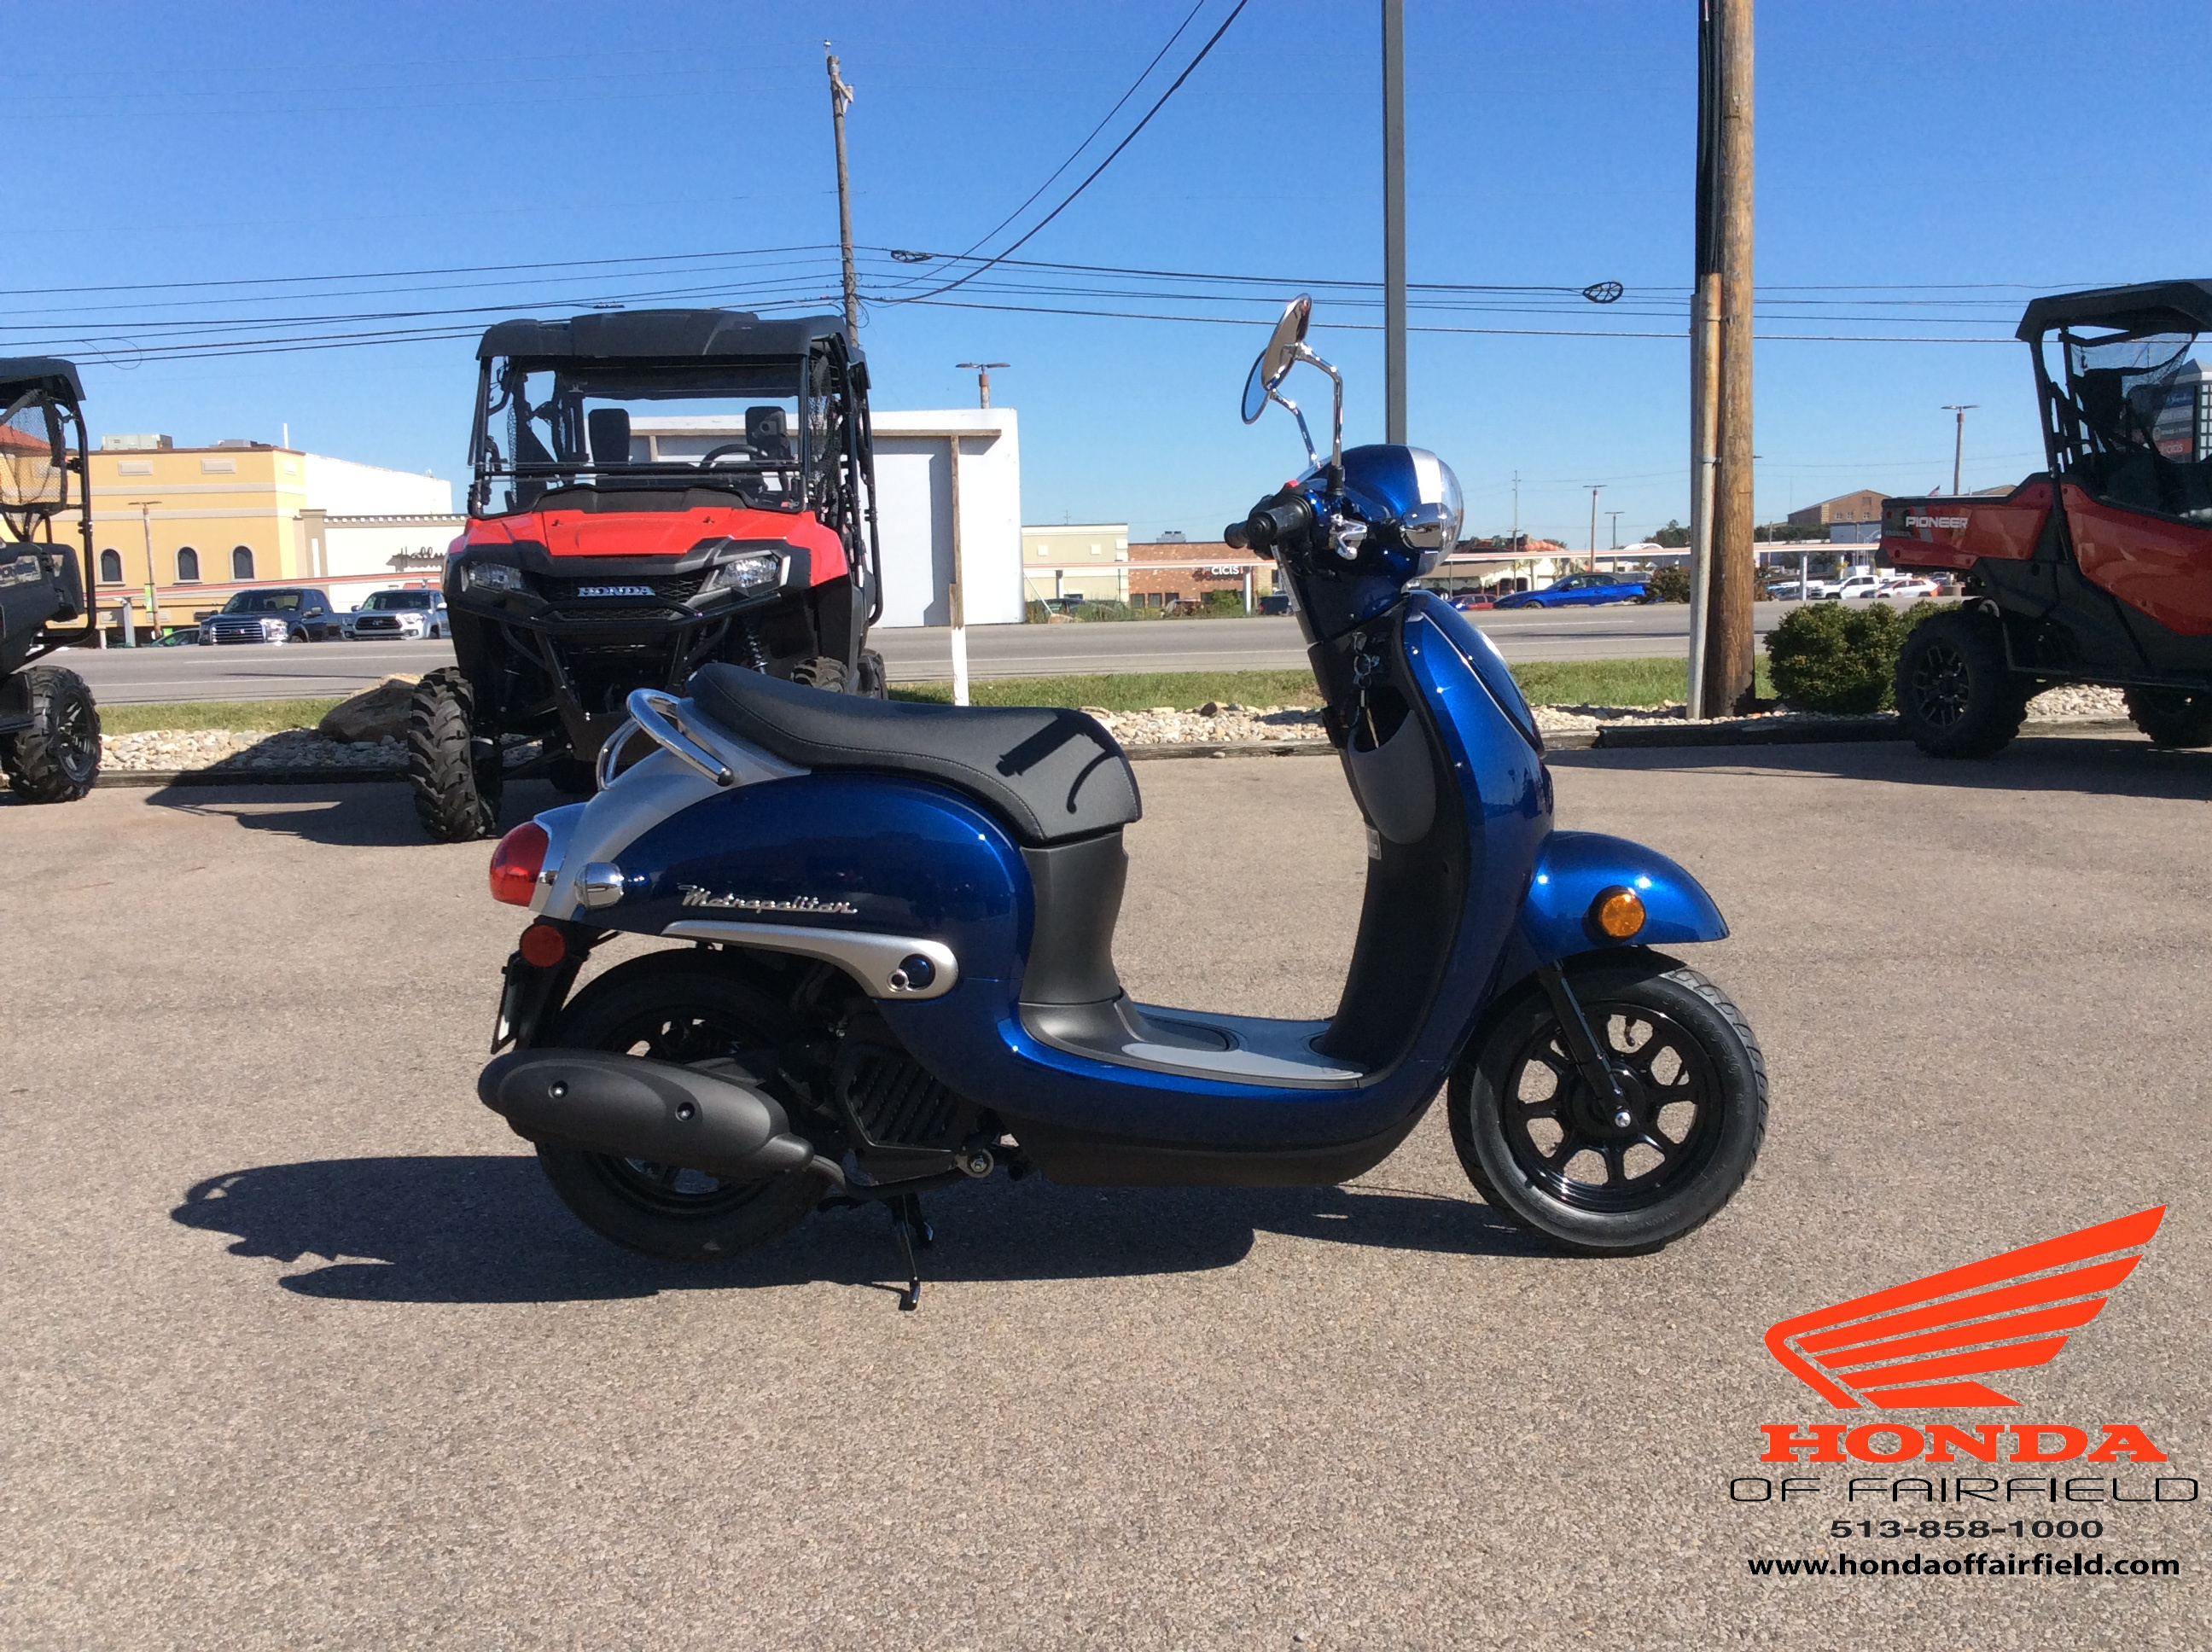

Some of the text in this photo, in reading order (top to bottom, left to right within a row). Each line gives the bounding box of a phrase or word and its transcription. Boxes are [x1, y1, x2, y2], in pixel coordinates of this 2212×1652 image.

[1906, 516, 1968, 528] PIONEER
[578, 586, 655, 597] HONDA
[678, 884, 858, 914] Metropolitan
